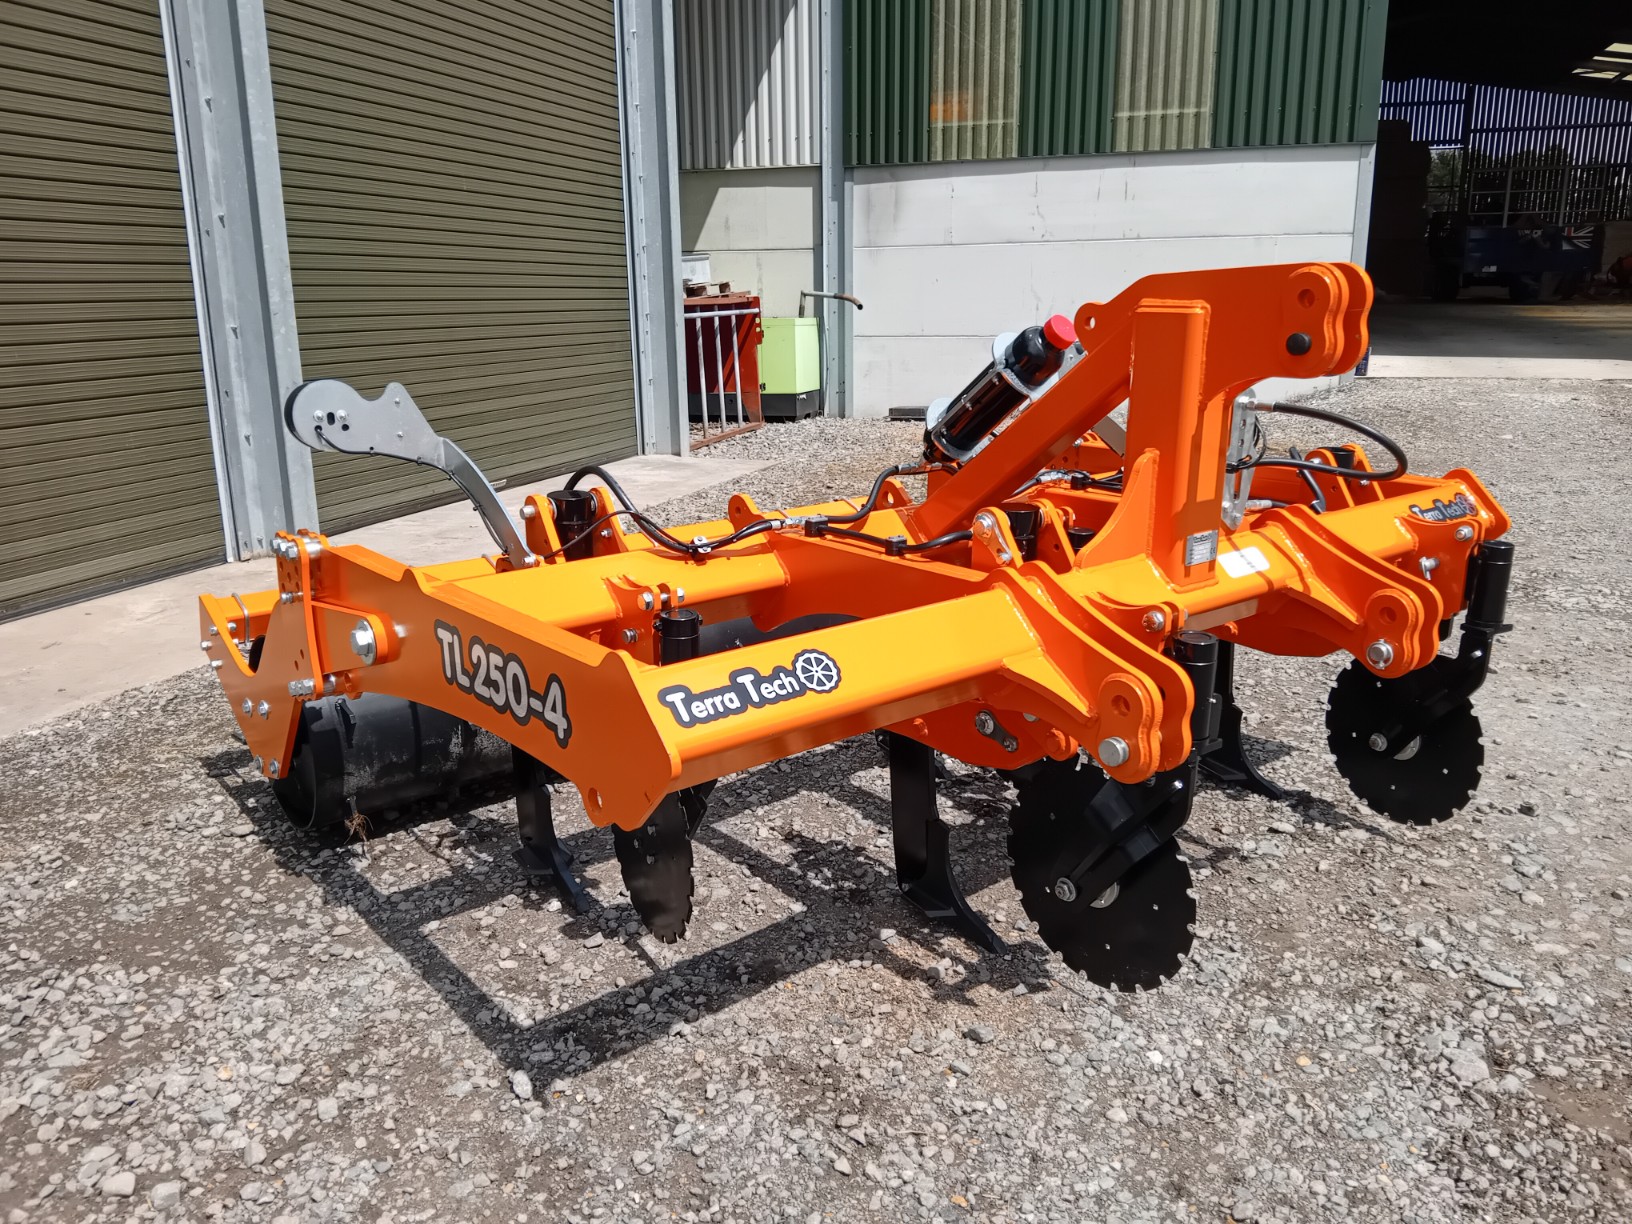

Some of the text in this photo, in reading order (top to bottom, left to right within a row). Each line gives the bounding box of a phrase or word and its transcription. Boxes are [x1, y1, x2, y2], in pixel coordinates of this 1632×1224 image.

[1435, 501, 1463, 518] Tech
[436, 627, 568, 740] TL250-4
[665, 673, 800, 723] Terra Tech
